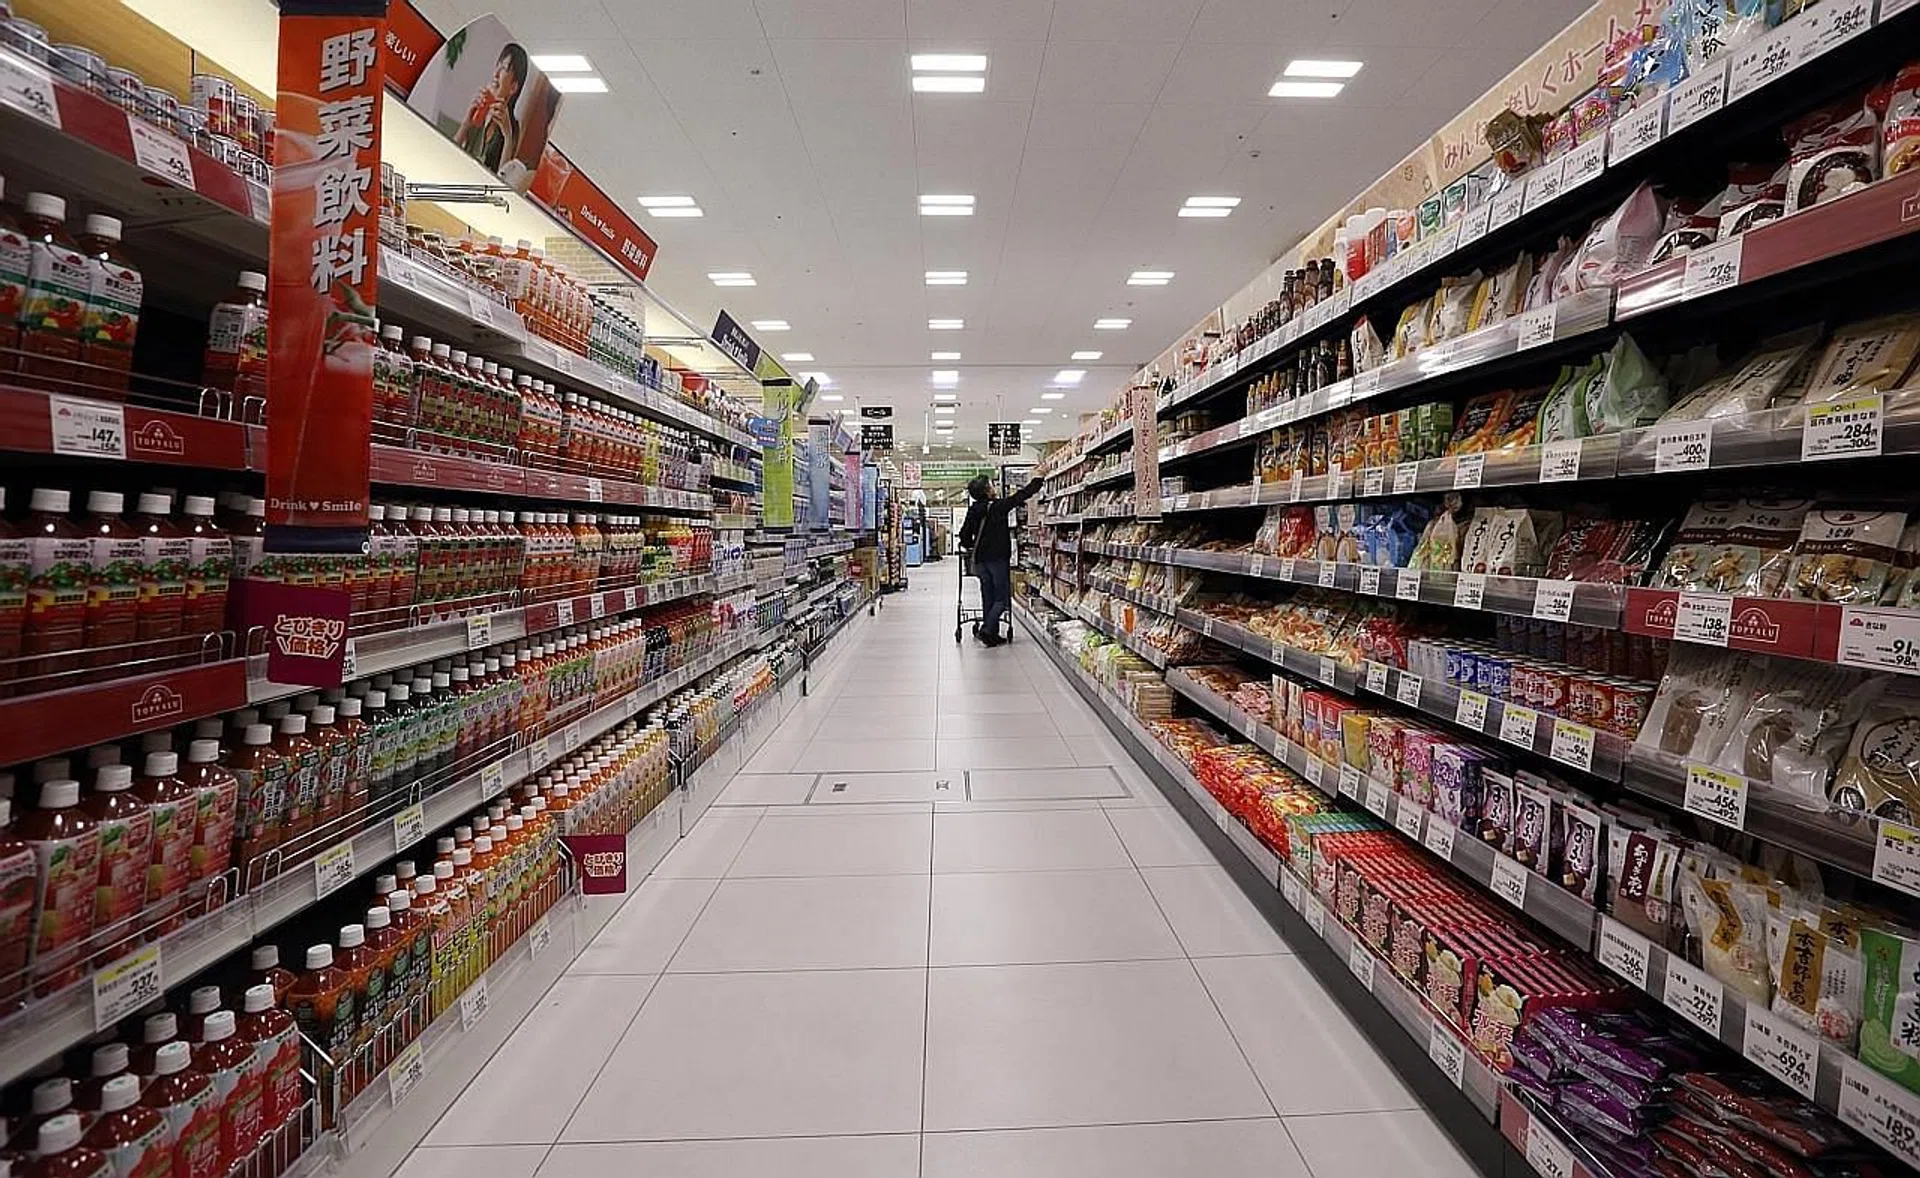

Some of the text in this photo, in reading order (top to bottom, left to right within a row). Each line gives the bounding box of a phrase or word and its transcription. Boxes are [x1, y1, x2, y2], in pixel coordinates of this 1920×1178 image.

[312, 27, 377, 294] 野菜飲料
[137, 436, 181, 450] TOPVALU
[271, 499, 362, 513] Drink Smile
[274, 614, 345, 641] とびきり
[1731, 625, 1775, 637] TOPVALU
[288, 636, 328, 657] 価格
[136, 701, 180, 717] TOPVALU
